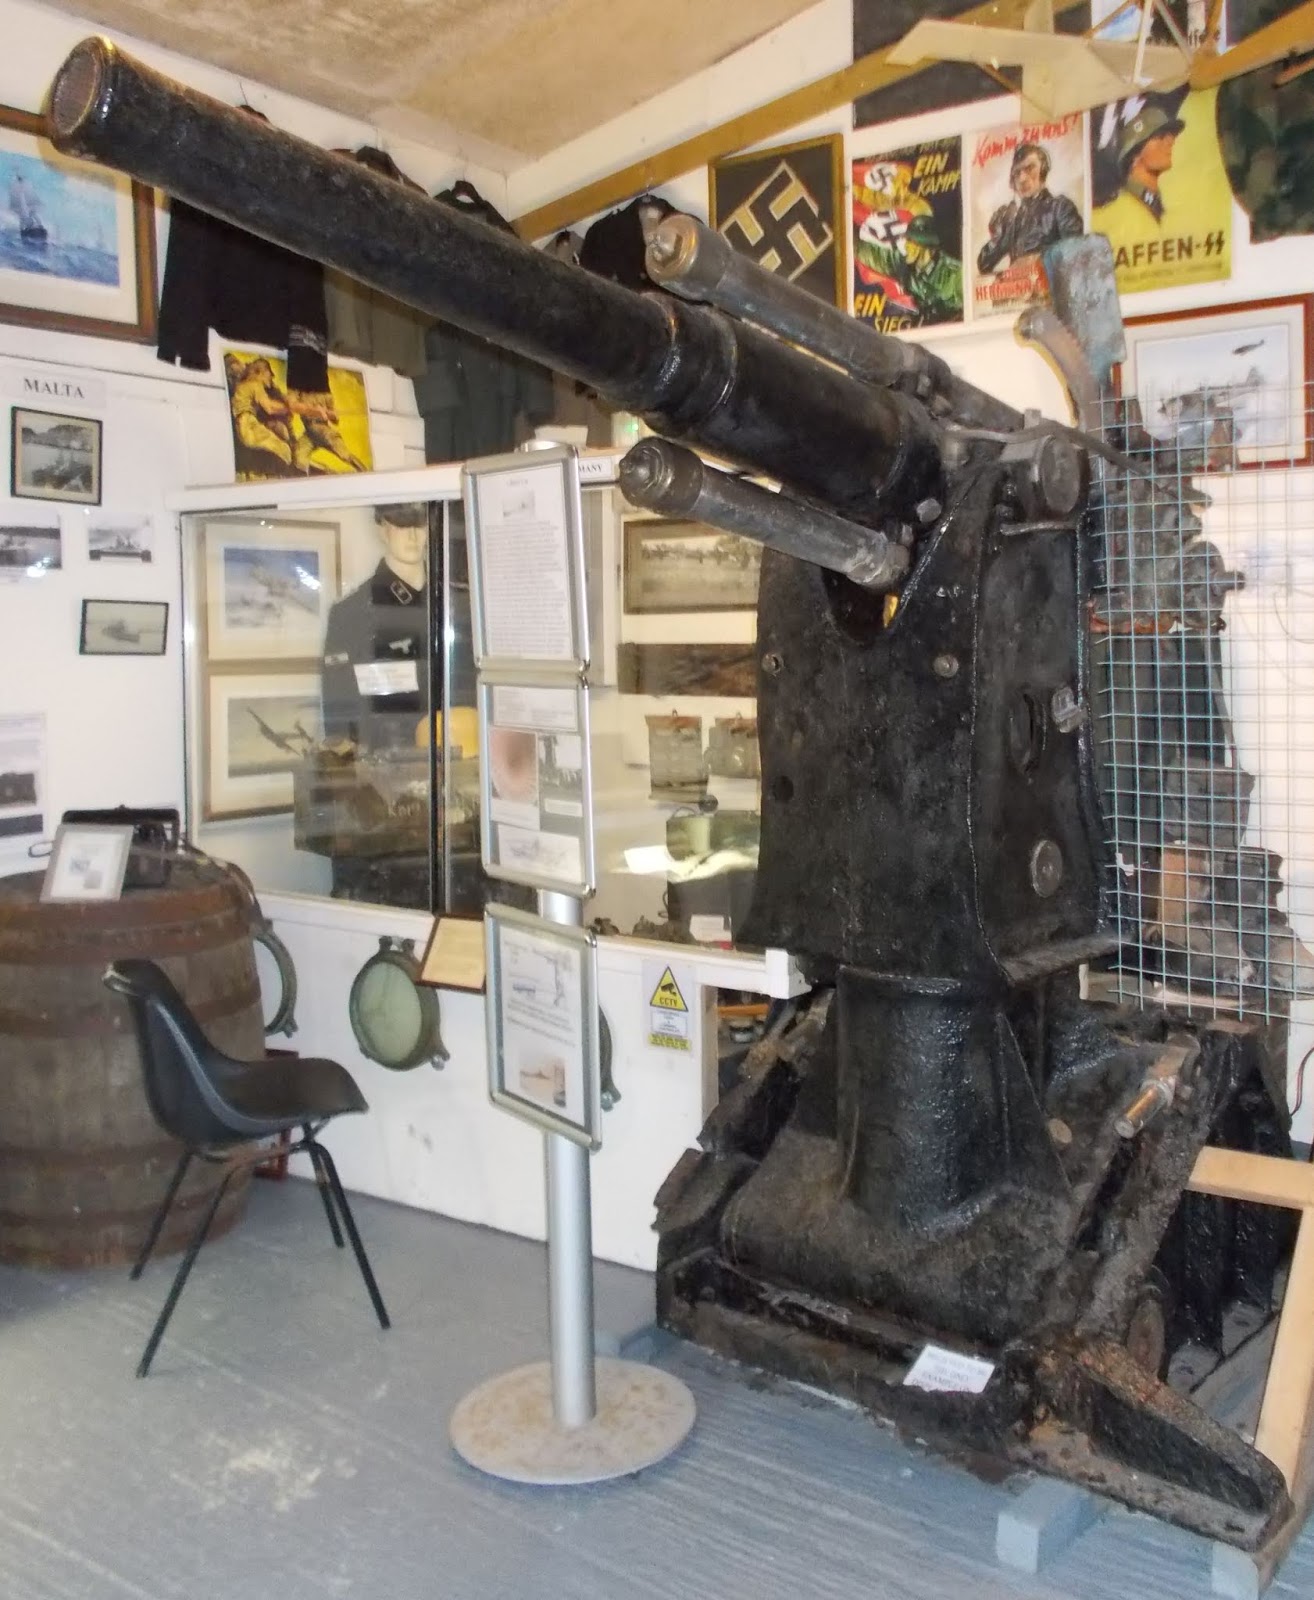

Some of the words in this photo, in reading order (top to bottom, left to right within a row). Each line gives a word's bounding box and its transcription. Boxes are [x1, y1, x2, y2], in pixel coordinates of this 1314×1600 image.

[913, 152, 949, 179] EIN
[1114, 231, 1225, 270] AFFEN-SS
[854, 293, 887, 317] EIN
[24, 378, 85, 399] MALTA
[579, 464, 602, 473] MANY
[659, 997, 678, 1007] CCTV
